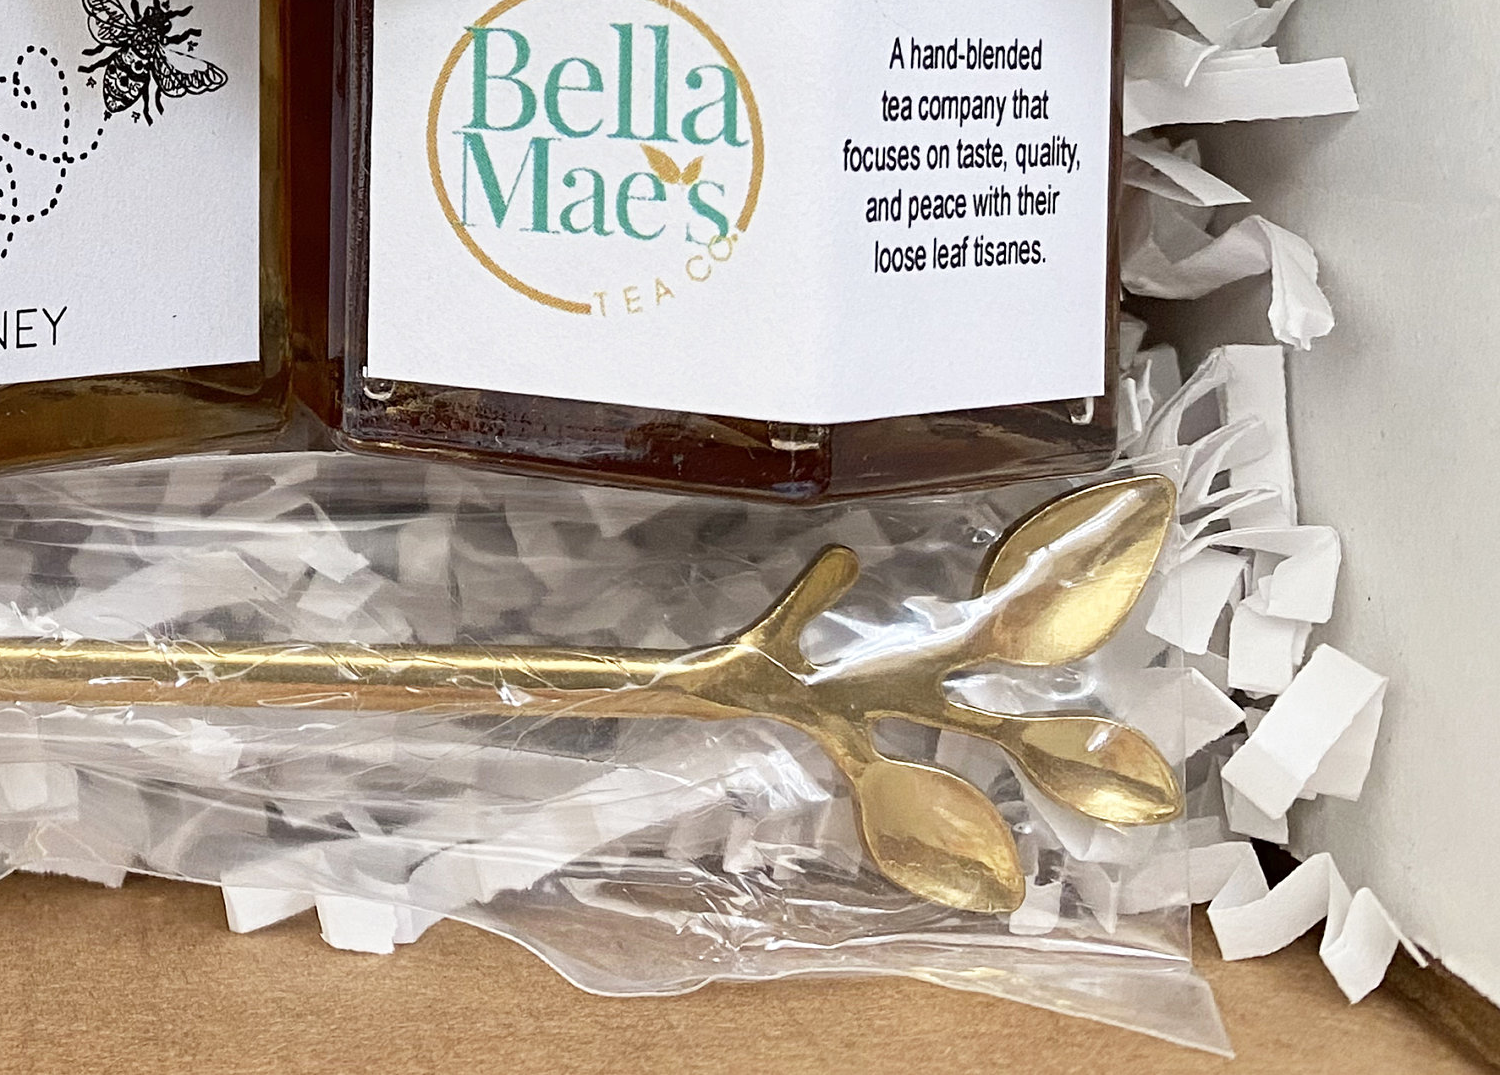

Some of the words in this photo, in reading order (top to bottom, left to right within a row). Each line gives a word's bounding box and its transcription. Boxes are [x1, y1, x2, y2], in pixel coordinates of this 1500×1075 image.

[889, 36, 905, 70] A
[910, 36, 1043, 71] hand-blended
[463, 22, 750, 148] Bella
[881, 90, 913, 122] tea
[918, 93, 1007, 128] company
[1012, 87, 1049, 120] that
[842, 138, 921, 173] focuses
[926, 144, 950, 170] on
[956, 137, 1007, 172] taste,
[1015, 135, 1080, 175] quality,
[865, 188, 902, 223] and
[908, 193, 967, 229] peace
[972, 184, 1011, 218] with
[1017, 184, 1061, 217] their
[874, 240, 927, 274] loose
[932, 235, 970, 270] leaf
[973, 234, 1046, 267] tisanes.
[592, 276, 676, 317] TEA
